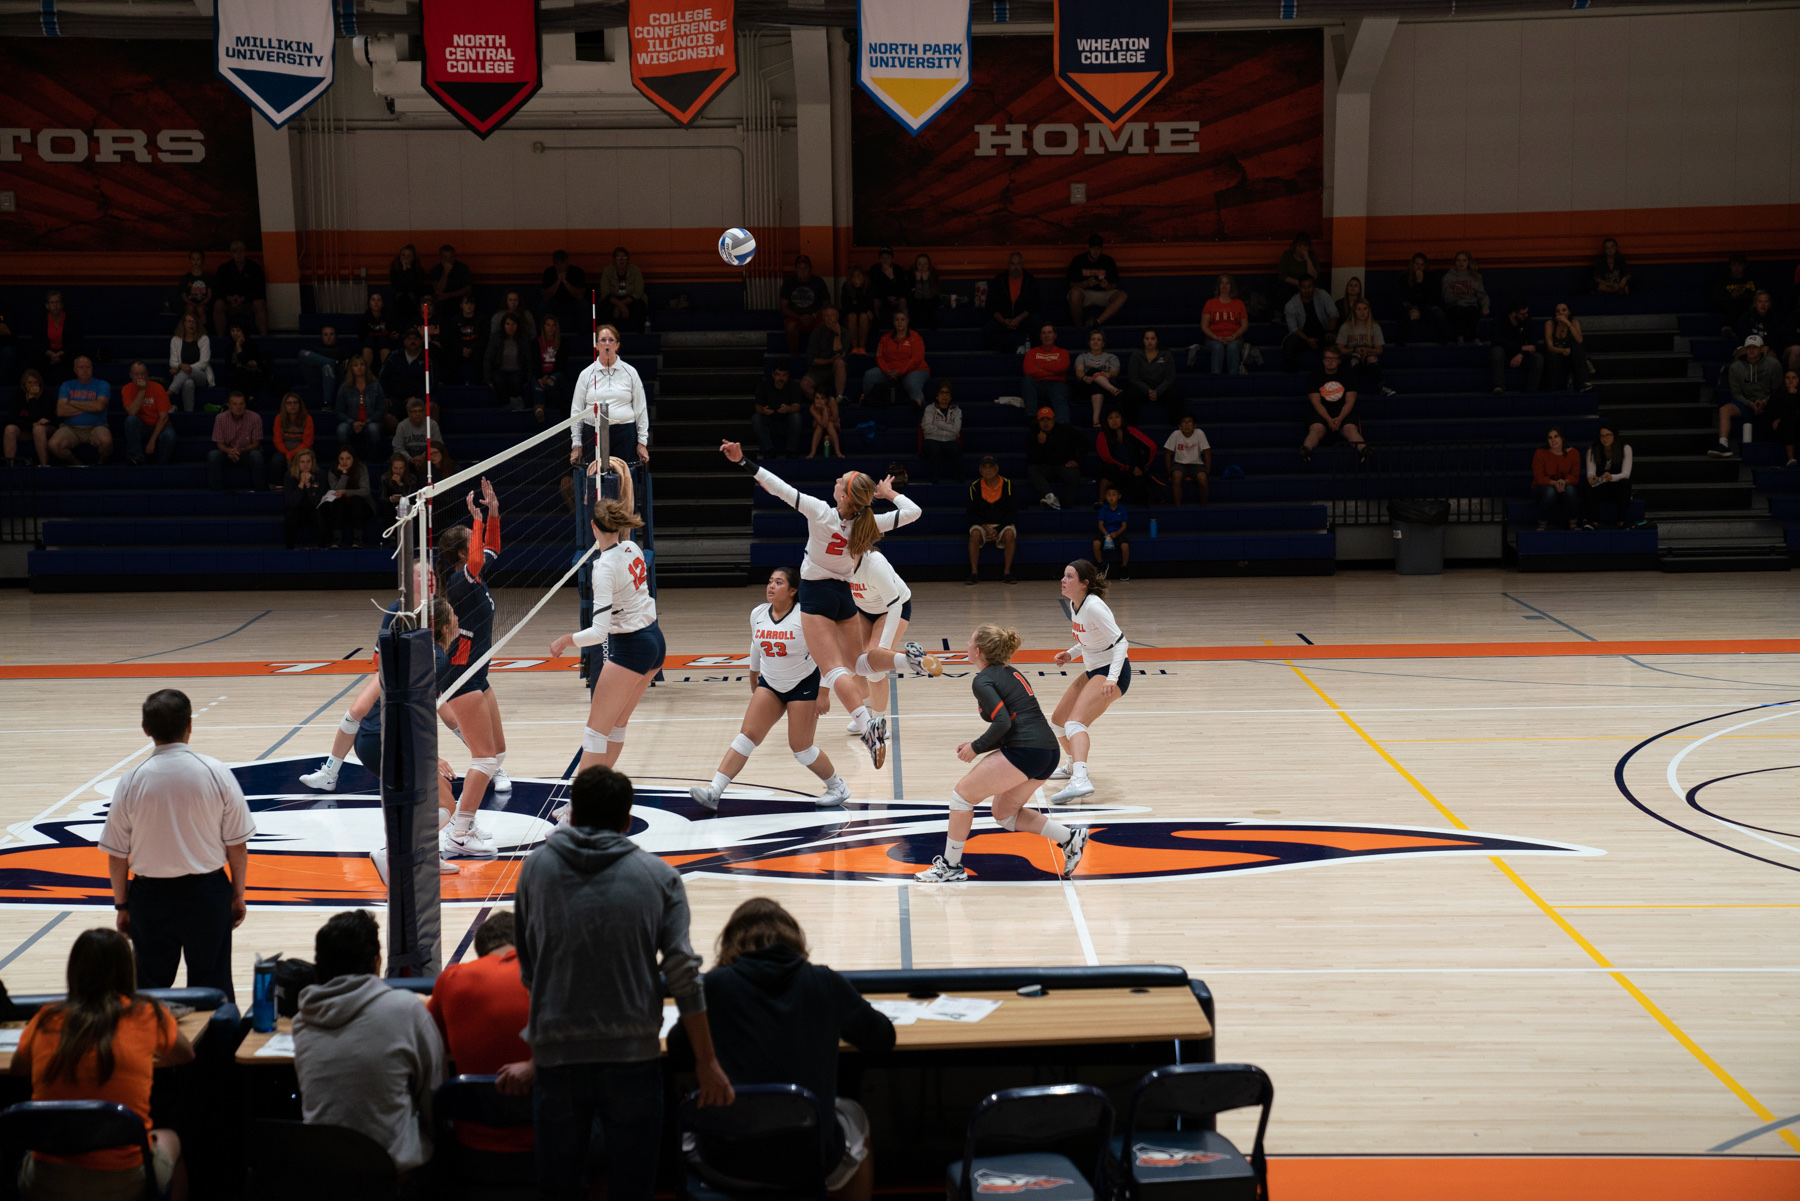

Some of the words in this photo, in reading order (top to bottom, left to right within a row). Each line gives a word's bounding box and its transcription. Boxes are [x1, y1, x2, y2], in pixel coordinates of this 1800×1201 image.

[649, 7, 713, 27] COLLEGE
[634, 19, 727, 39] CONFERENCE
[235, 36, 313, 54] MILLIKIN
[452, 34, 507, 47] NORTH
[647, 32, 715, 52] ILLINOIS
[868, 42, 919, 56] NORTH
[922, 43, 963, 56] PARK
[1076, 37, 1150, 52] WHEATON
[225, 46, 324, 68] UNIVERSITY
[445, 47, 515, 61] CENTRAL
[637, 43, 725, 65] WISCONSIN
[869, 55, 962, 69] UNIVERSITY
[1080, 50, 1146, 64] COLLEGE
[446, 60, 515, 74] COLLEGE
[0, 127, 206, 163] TORS
[974, 121, 1200, 157] HOME
[825, 532, 848, 556] 2
[628, 556, 647, 591] 12
[850, 582, 868, 591] ROLL
[754, 629, 796, 640] CARROLL
[760, 640, 788, 657] 23
[1013, 671, 1034, 696] 1
